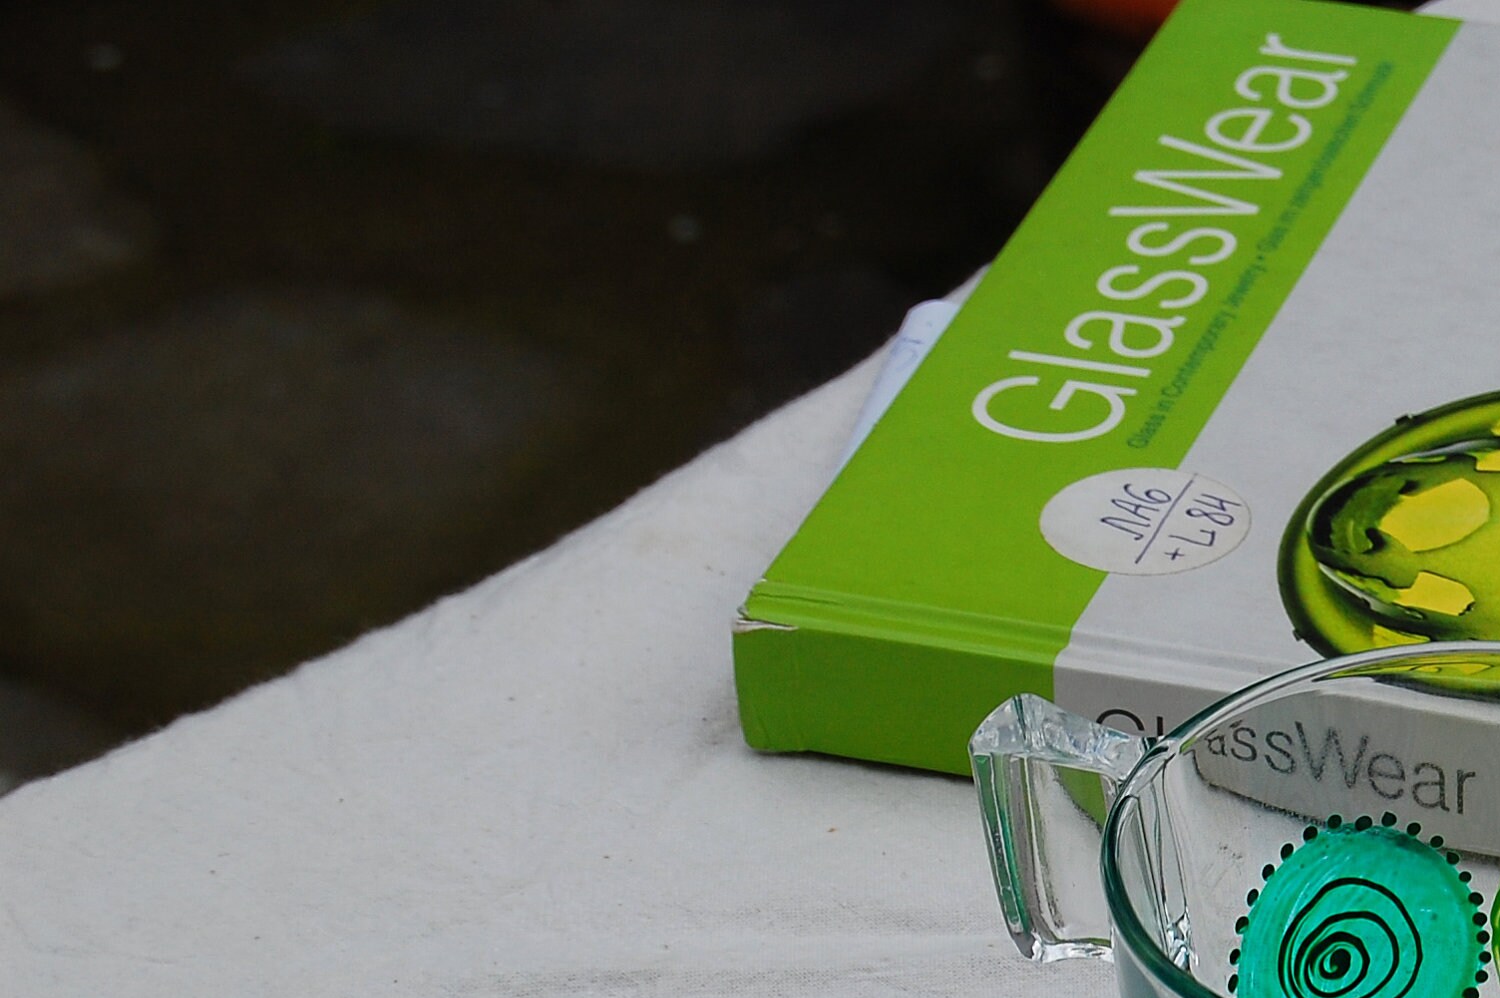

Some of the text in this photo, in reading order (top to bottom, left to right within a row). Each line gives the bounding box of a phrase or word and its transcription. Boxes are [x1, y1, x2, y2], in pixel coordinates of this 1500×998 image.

[972, 33, 1358, 442] GlassWear
[1127, 414, 1166, 448] Glass
[1096, 709, 1475, 814] assWear
